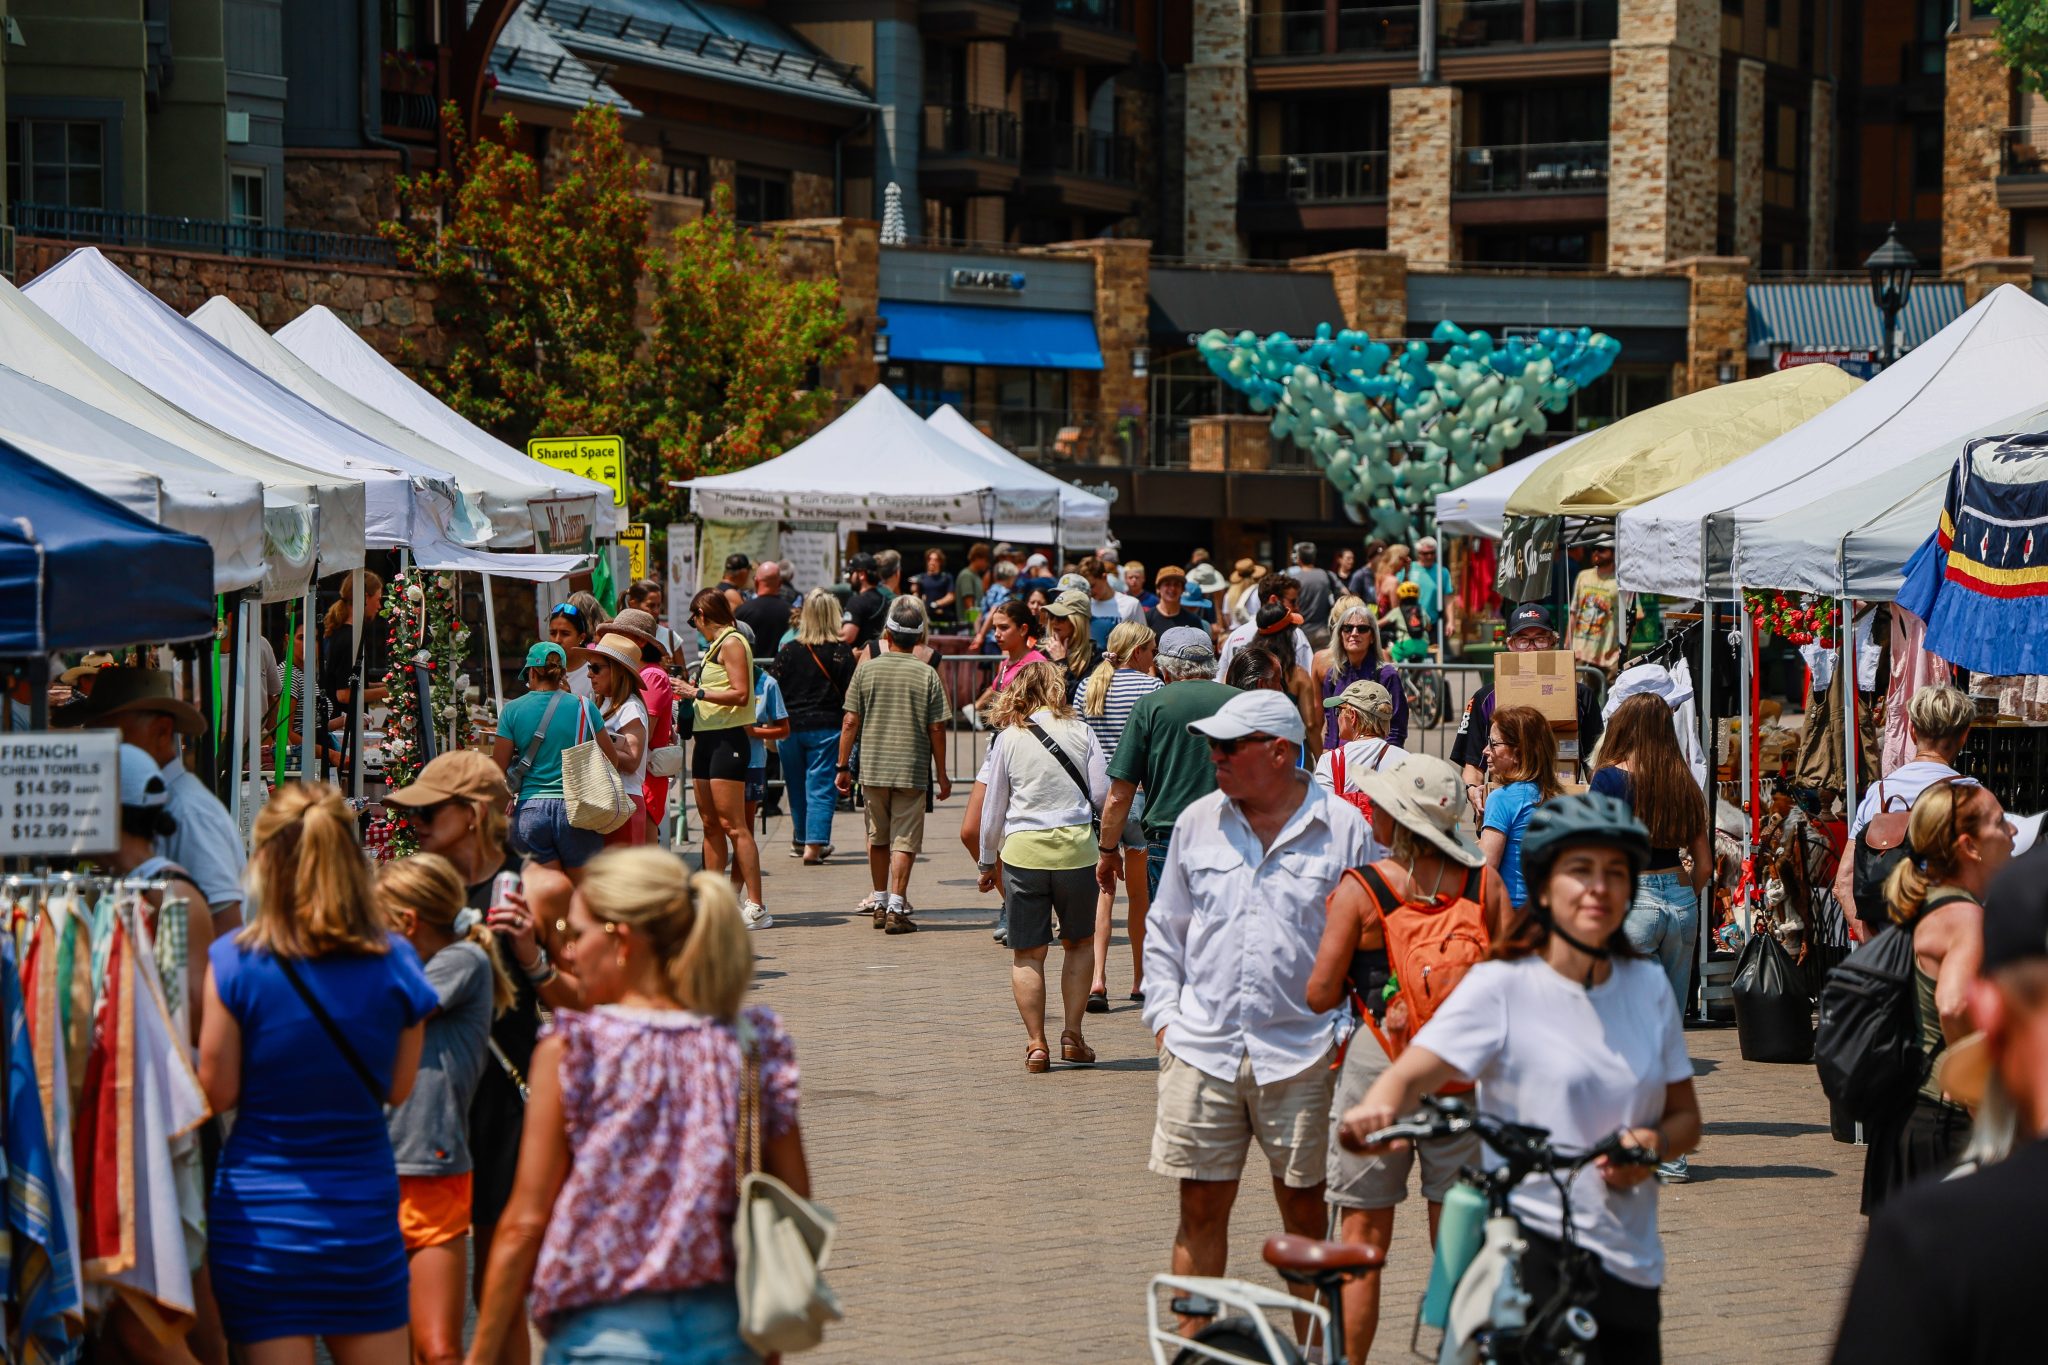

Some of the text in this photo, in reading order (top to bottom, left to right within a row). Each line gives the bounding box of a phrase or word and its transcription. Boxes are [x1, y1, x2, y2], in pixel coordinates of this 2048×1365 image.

[537, 446, 615, 460] Shared Space
[800, 494, 819, 504] Sun
[822, 495, 854, 505] Cream
[877, 496, 922, 507] Chapped
[925, 498, 947, 507] Lips
[723, 506, 937, 521] Puffy Eyes Pet Products Bug Spray
[622, 528, 643, 538] SLOW
[1519, 610, 1540, 619] FedEx
[1457, 698, 1474, 734] FedEx
[1, 744, 78, 759] FRENCH
[44, 763, 100, 775] TOWELS
[15, 780, 71, 796] $14.99
[14, 803, 70, 818] $13.99
[12, 823, 68, 839] $12.99
